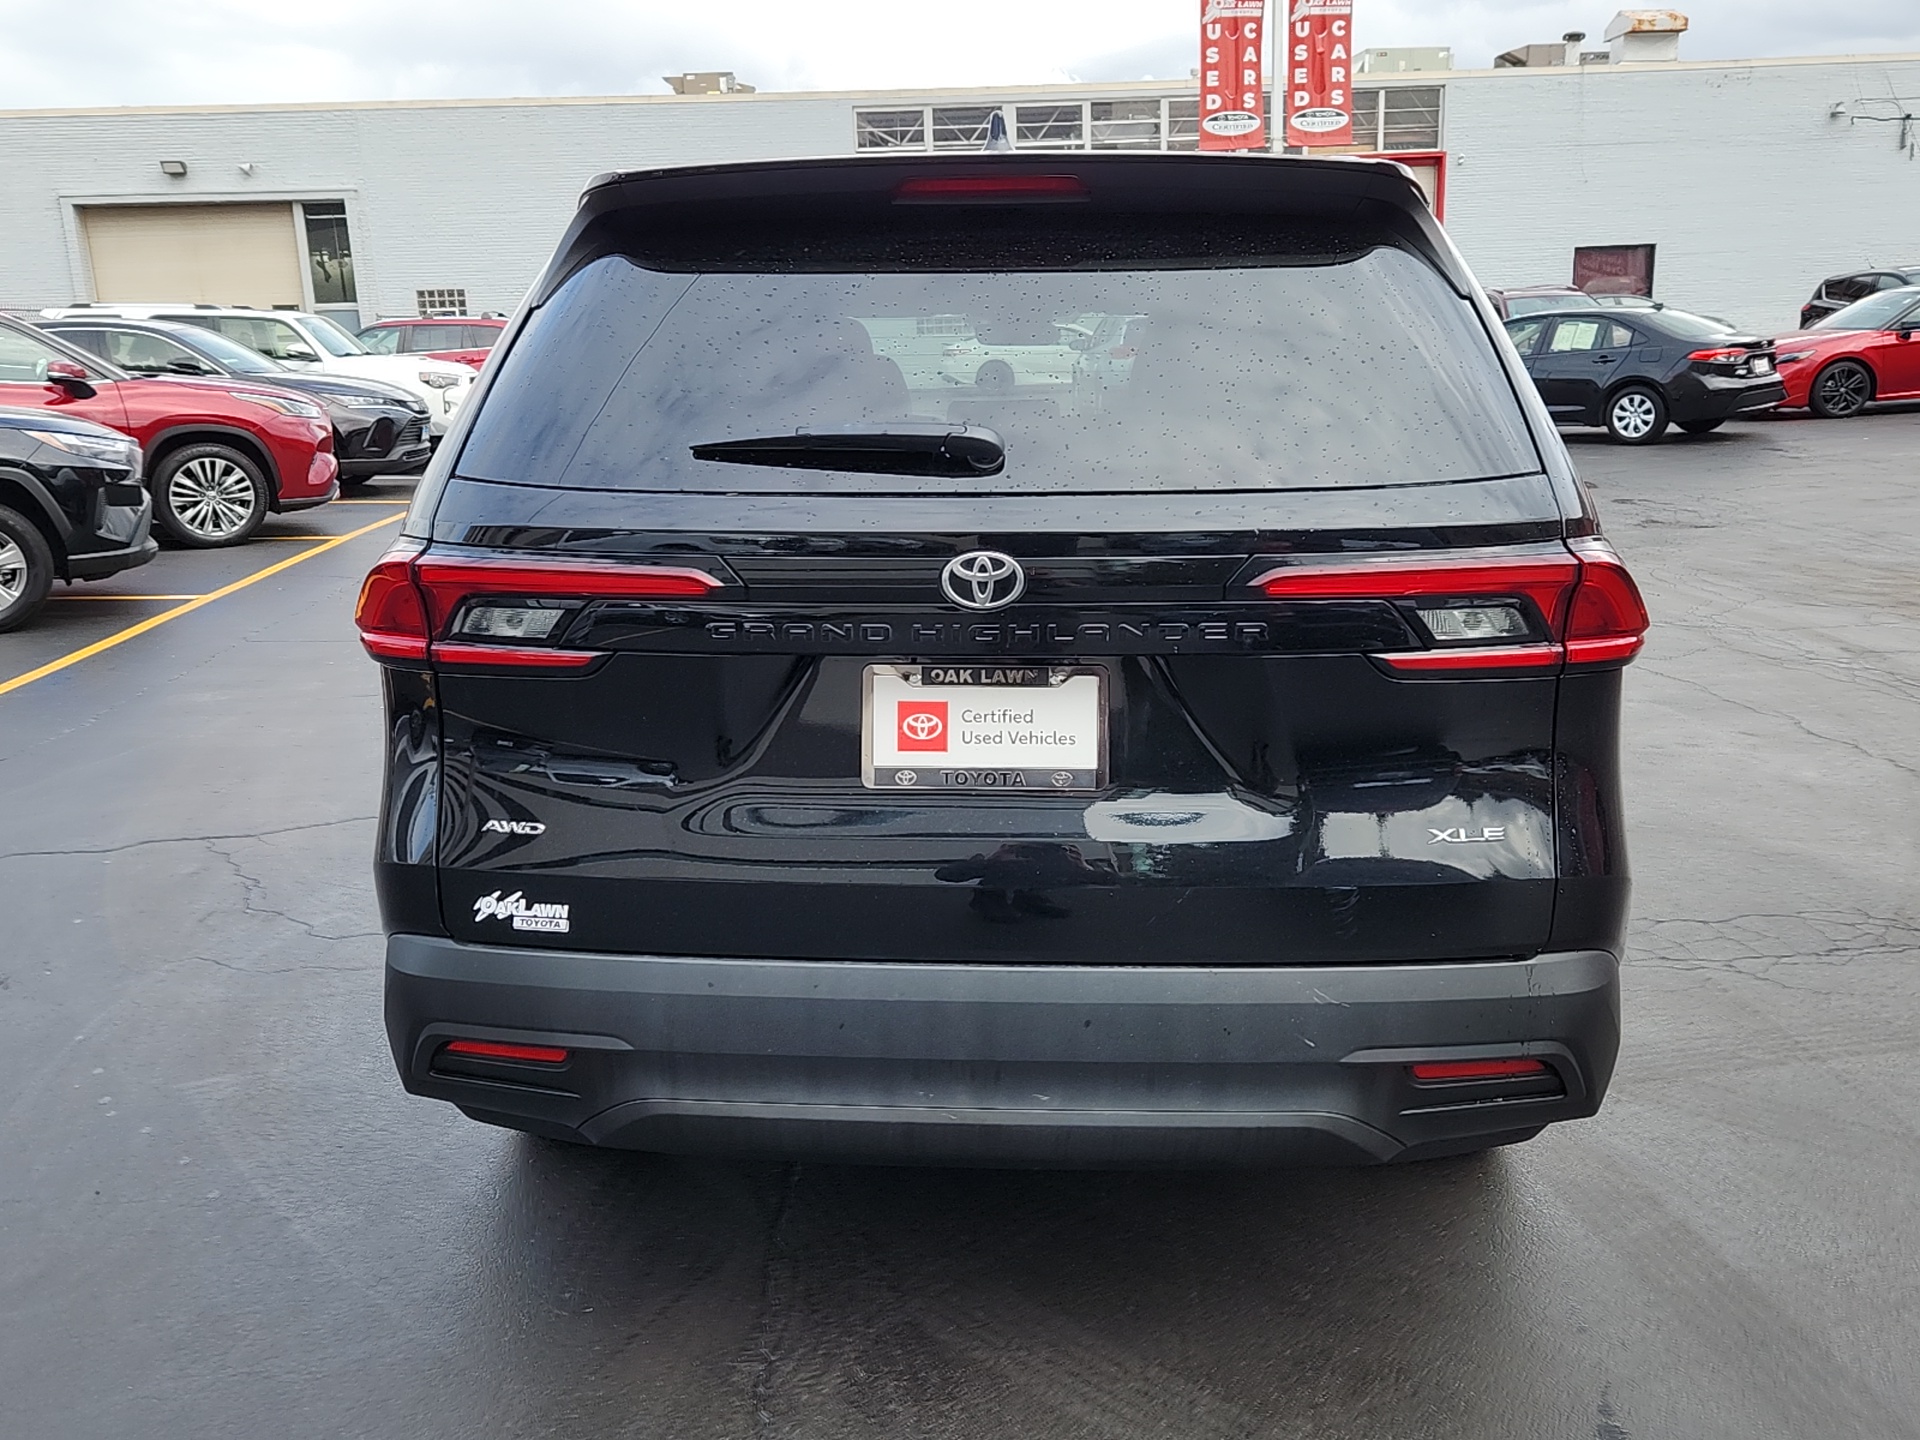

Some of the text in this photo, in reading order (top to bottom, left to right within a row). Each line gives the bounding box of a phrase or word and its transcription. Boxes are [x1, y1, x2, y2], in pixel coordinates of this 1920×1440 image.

[1206, 23, 1222, 110] USED
[1243, 22, 1258, 108] CARS
[1294, 21, 1310, 107] USED
[1331, 20, 1347, 105] CARS
[705, 622, 1269, 643] GRAND HIGHLANDER
[930, 669, 1039, 684] OAK LAWN
[961, 709, 1034, 724] Certified
[961, 731, 1076, 746] Used Vehicles
[940, 770, 1027, 787] TOYOTA
[481, 819, 546, 835] AWD
[1426, 826, 1505, 845] XLE
[519, 918, 561, 928] TOYOTA
